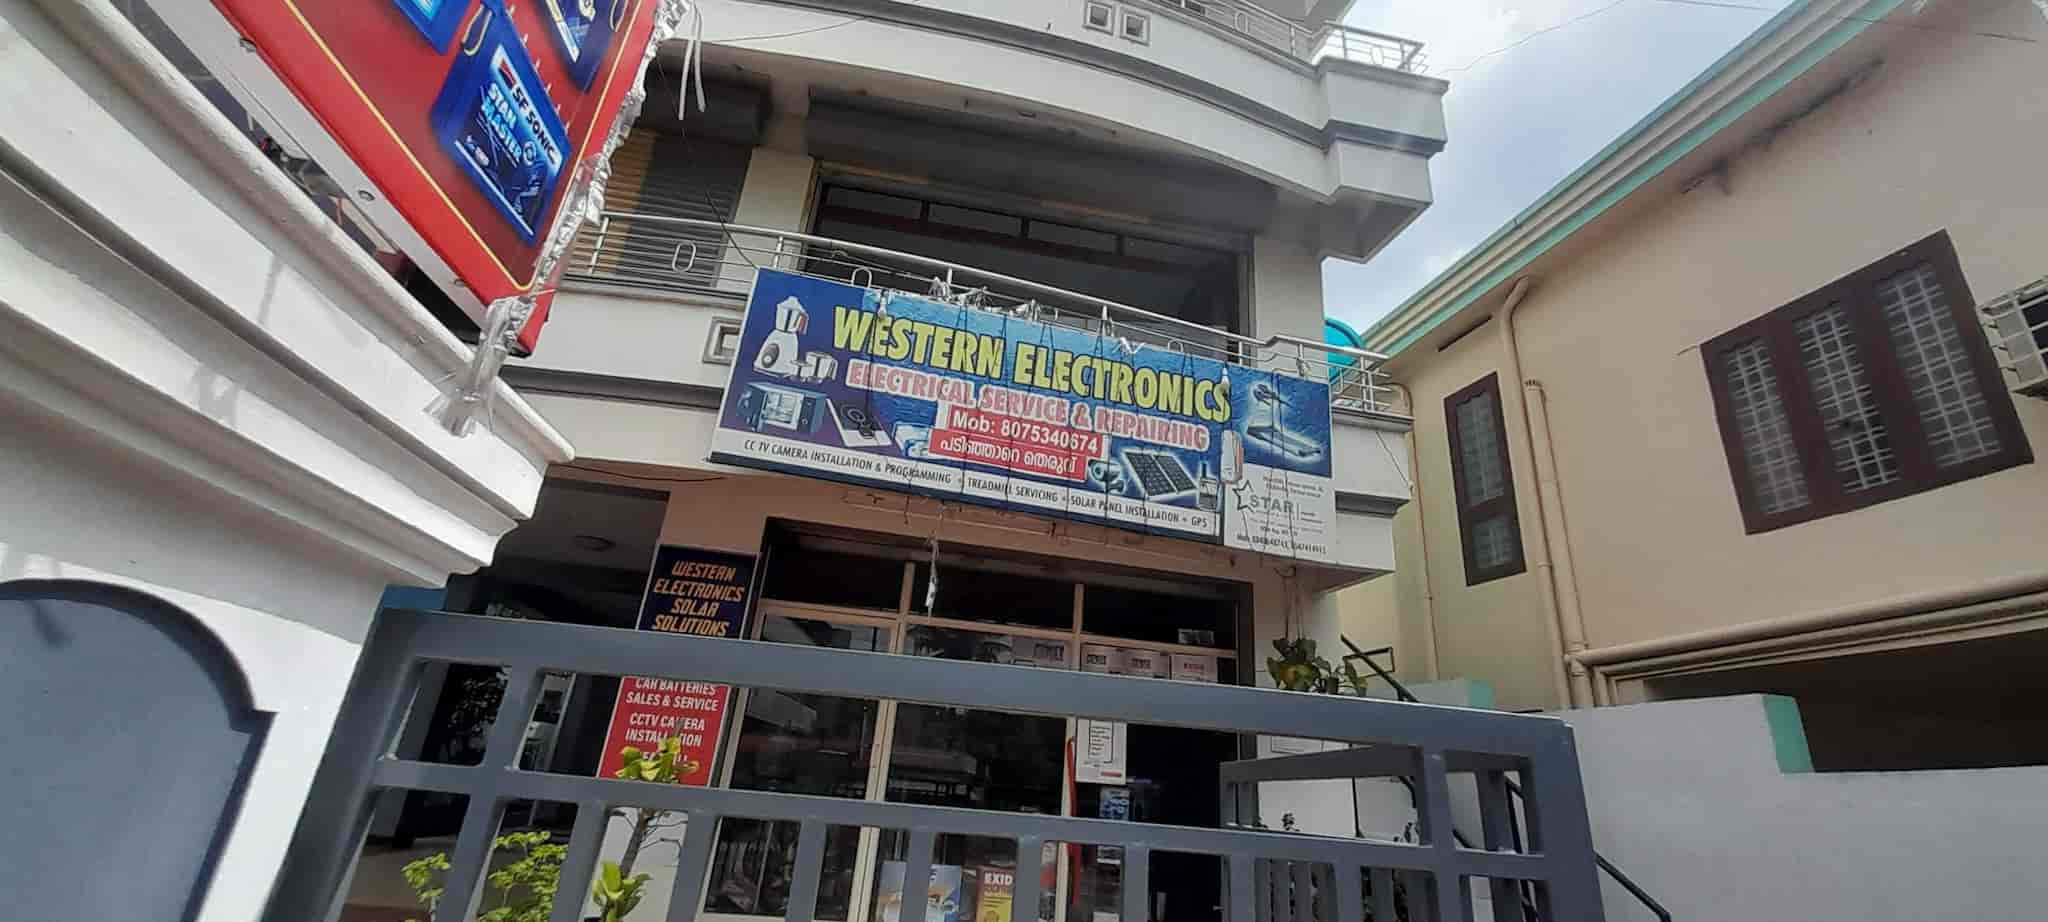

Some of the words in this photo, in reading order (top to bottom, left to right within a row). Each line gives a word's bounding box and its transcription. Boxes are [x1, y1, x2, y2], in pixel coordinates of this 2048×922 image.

[512, 87, 529, 109] SF
[526, 111, 555, 165] SONIC
[833, 305, 1005, 379] WESTERN
[1013, 342, 1232, 423] ELECTRONICS
[846, 358, 976, 405] ELECTRICAL
[979, 385, 1070, 426] SERVICE
[1070, 401, 1093, 431] &
[1095, 406, 1211, 452] REPAIRING
[953, 410, 996, 434] Mob:
[1001, 419, 1098, 454] 8075340674
[759, 441, 771, 453] TV
[771, 443, 808, 460] CAMERA
[810, 450, 873, 472] INSTALLATION
[875, 461, 882, 472] &
[884, 463, 952, 484] PROGRAMMING
[967, 477, 1013, 495] TREADMILL
[1015, 486, 1059, 503] SERVICING
[1071, 495, 1096, 509] SOLAR
[1098, 500, 1123, 514] PANEL
[1125, 504, 1179, 523] INSTALLATION
[1191, 515, 1208, 528] GPS
[1250, 494, 1294, 513] STAR
[671, 560, 737, 582] WESTERN
[654, 578, 745, 603] ELECTRONICS
[670, 598, 720, 617] SOLAR
[652, 614, 731, 637] SOLUTIONS
[635, 678, 658, 690] CAR
[659, 679, 716, 696] BATTERIES
[626, 691, 661, 706] SALES
[662, 695, 670, 706] &
[672, 695, 719, 711] SERVICE
[629, 712, 659, 725] CCTV
